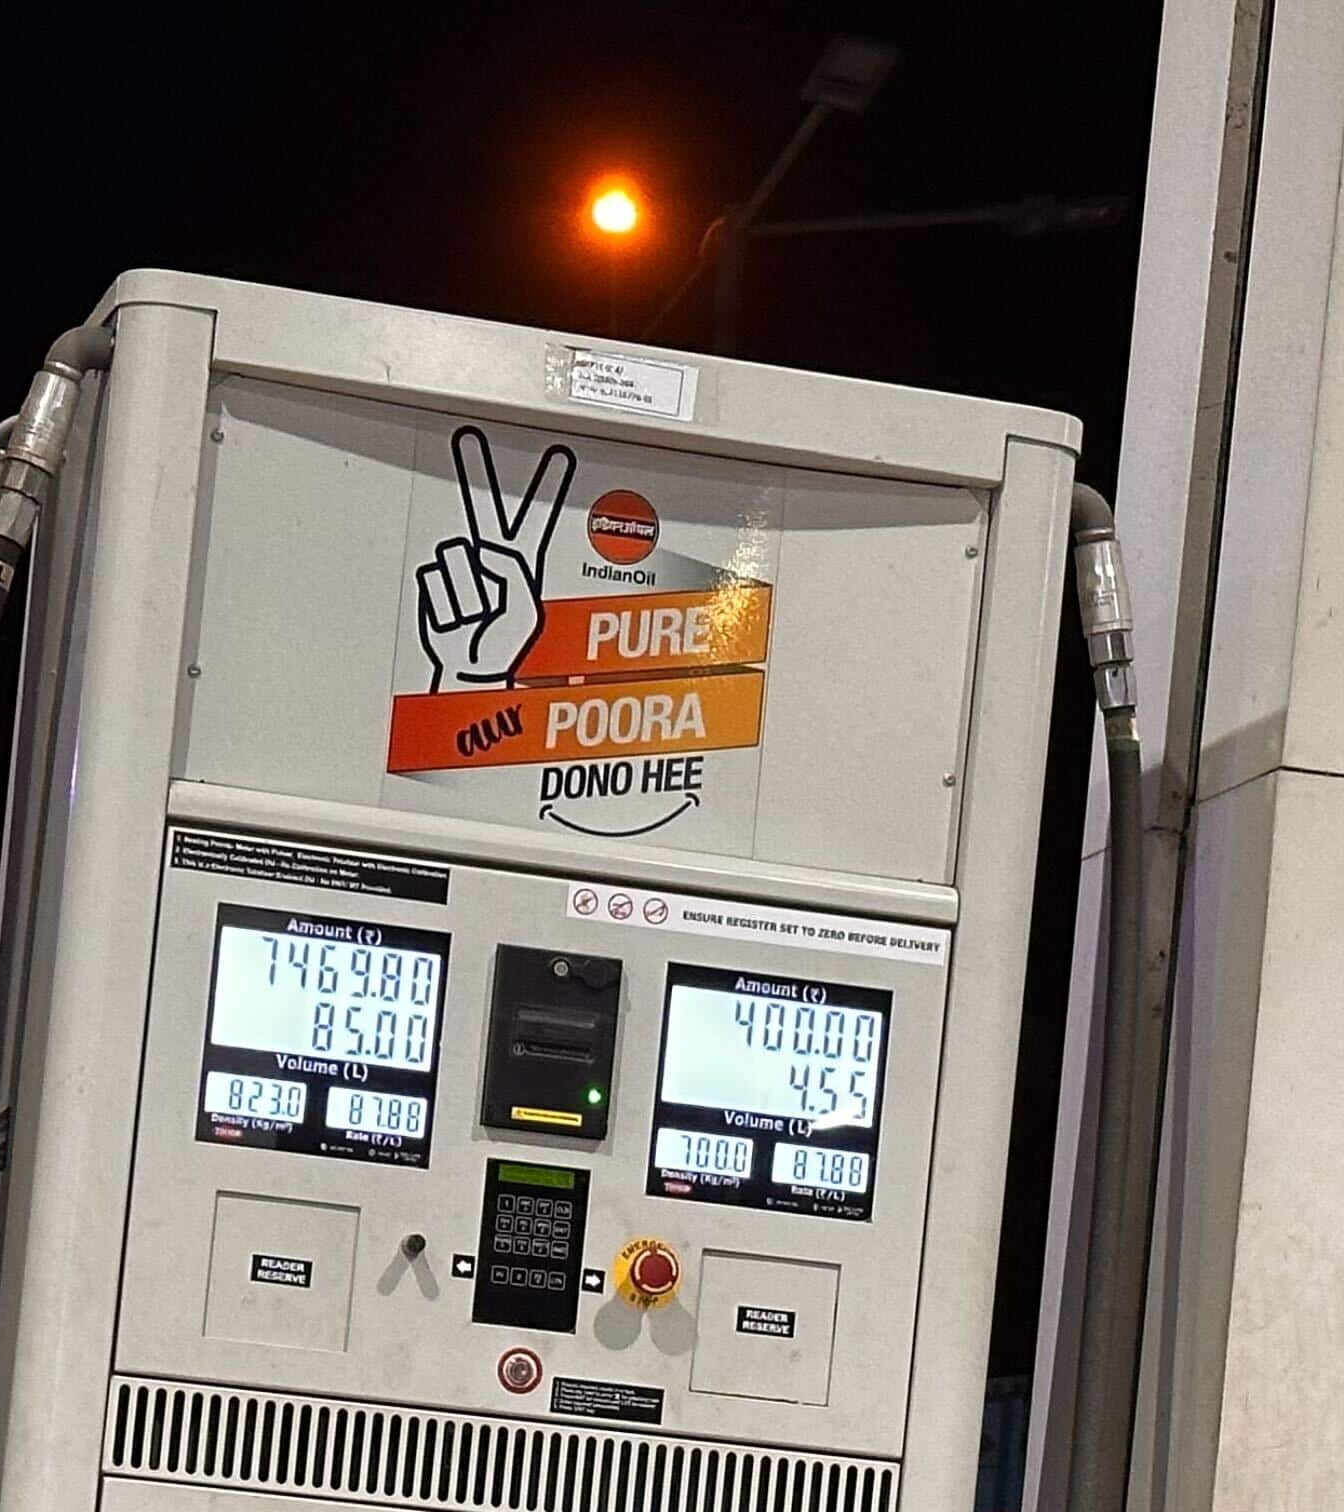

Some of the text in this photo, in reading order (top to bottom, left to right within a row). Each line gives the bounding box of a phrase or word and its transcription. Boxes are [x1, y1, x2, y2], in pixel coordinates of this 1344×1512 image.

[582, 562, 656, 586] IndianOil
[586, 606, 712, 662] PURE
[544, 692, 706, 751] POORA
[540, 756, 705, 802] DONO HEE
[287, 918, 352, 941] Amount
[682, 910, 941, 952] ENSURE REGISTER SET TO ZERO BEFORE DELIVERY
[262, 936, 433, 1006] 7469.80
[735, 976, 797, 999] Amount
[312, 1002, 427, 1064] 85.00
[735, 999, 875, 1062] 400.00
[276, 1053, 338, 1076] Volume
[229, 1078, 301, 1118] 823.0
[789, 1065, 868, 1120] 4.55
[348, 1094, 421, 1132] 87.88
[724, 1110, 783, 1131] Volume
[680, 1135, 748, 1173] 700.0
[793, 1150, 863, 1187] 87.88
[257, 1269, 306, 1285] RESERVE
[260, 1257, 305, 1273] READER
[742, 1320, 790, 1335] RESERVE
[745, 1309, 789, 1323] READER
